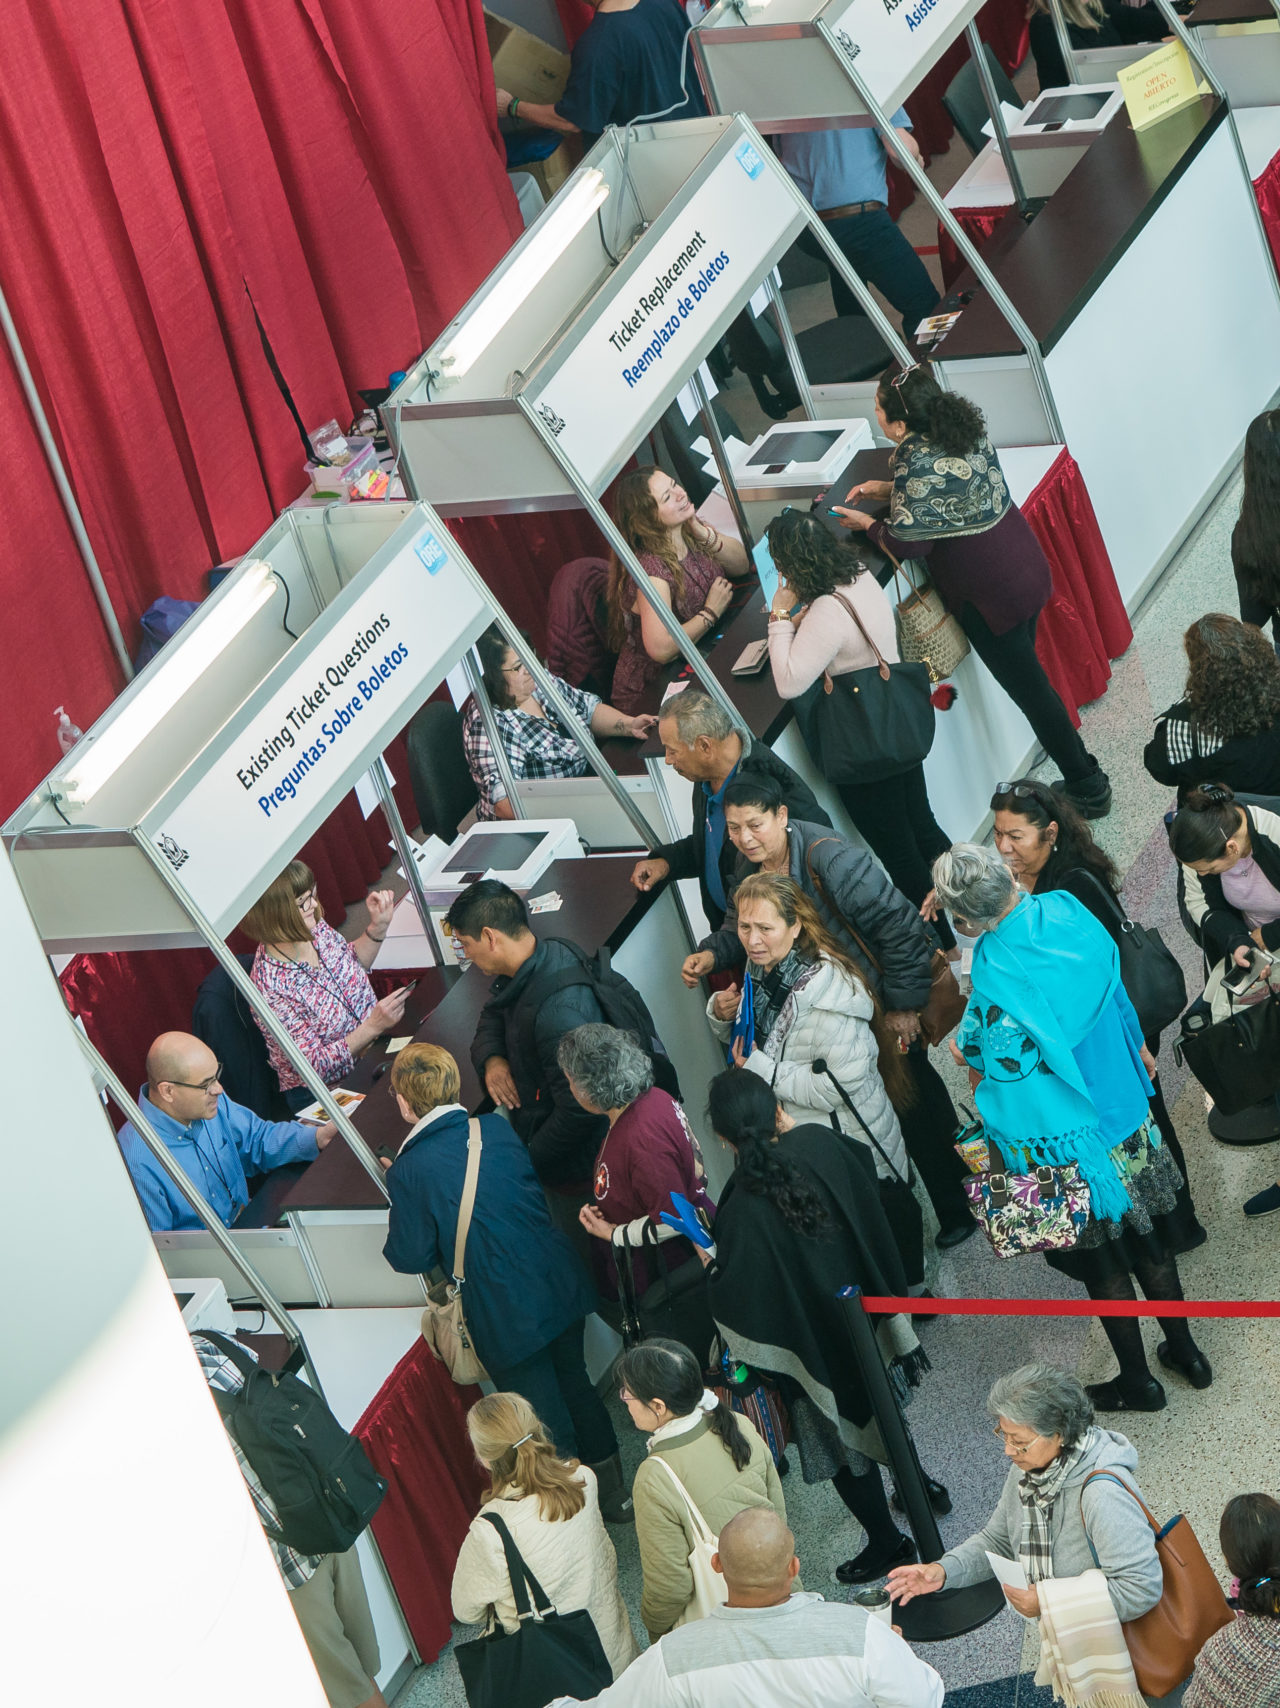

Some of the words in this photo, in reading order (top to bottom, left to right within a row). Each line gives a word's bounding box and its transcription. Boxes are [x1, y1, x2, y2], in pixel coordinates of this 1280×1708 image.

[882, 0, 902, 15] As
[905, 0, 939, 32] Asiste
[1144, 77, 1176, 99] ABIERTO
[1146, 72, 1167, 87] OPEN
[609, 309, 646, 352] Ticket
[639, 230, 706, 315] Replacement
[622, 315, 680, 388] Reemplazo
[677, 298, 694, 319] de
[688, 250, 730, 302] Boletos
[236, 726, 295, 791] Existing
[286, 682, 330, 730] Ticket
[325, 613, 391, 687] Questions
[257, 739, 327, 817] Preguntas
[321, 696, 363, 744] Sobre
[357, 642, 409, 701] Boletos
